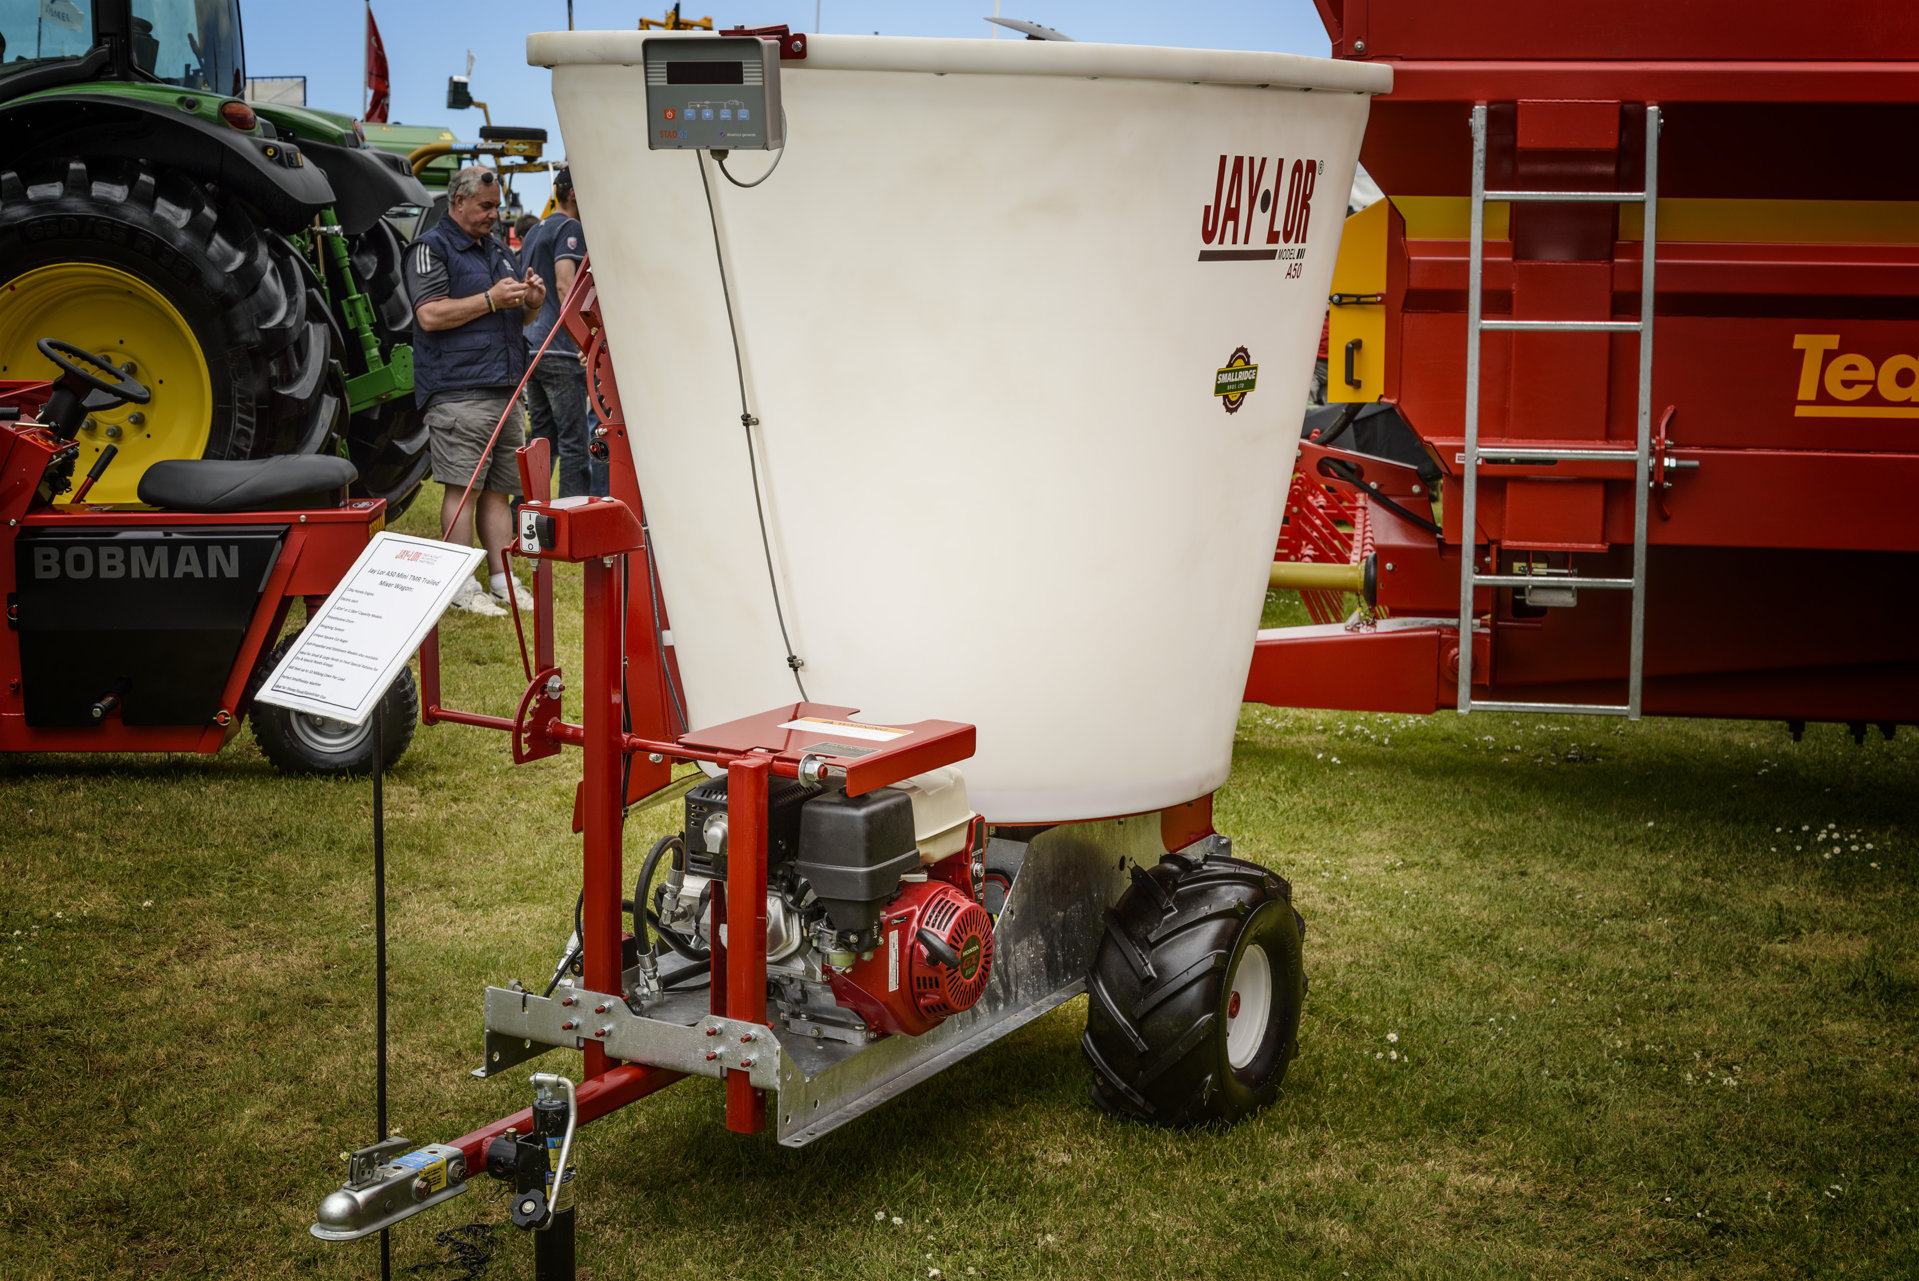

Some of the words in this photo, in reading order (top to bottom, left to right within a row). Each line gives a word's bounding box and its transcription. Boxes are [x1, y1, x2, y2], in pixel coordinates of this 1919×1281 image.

[1278, 248, 1296, 260] MODEL
[1285, 262, 1302, 279] A50
[1217, 370, 1256, 384] SMALLRIDGE
[34, 546, 240, 579] BOBMAN
[378, 580, 394, 589] Mixer
[386, 570, 396, 578] A50
[396, 571, 408, 580] Mini
[410, 574, 422, 582] TMR
[422, 576, 440, 586] Trailed
